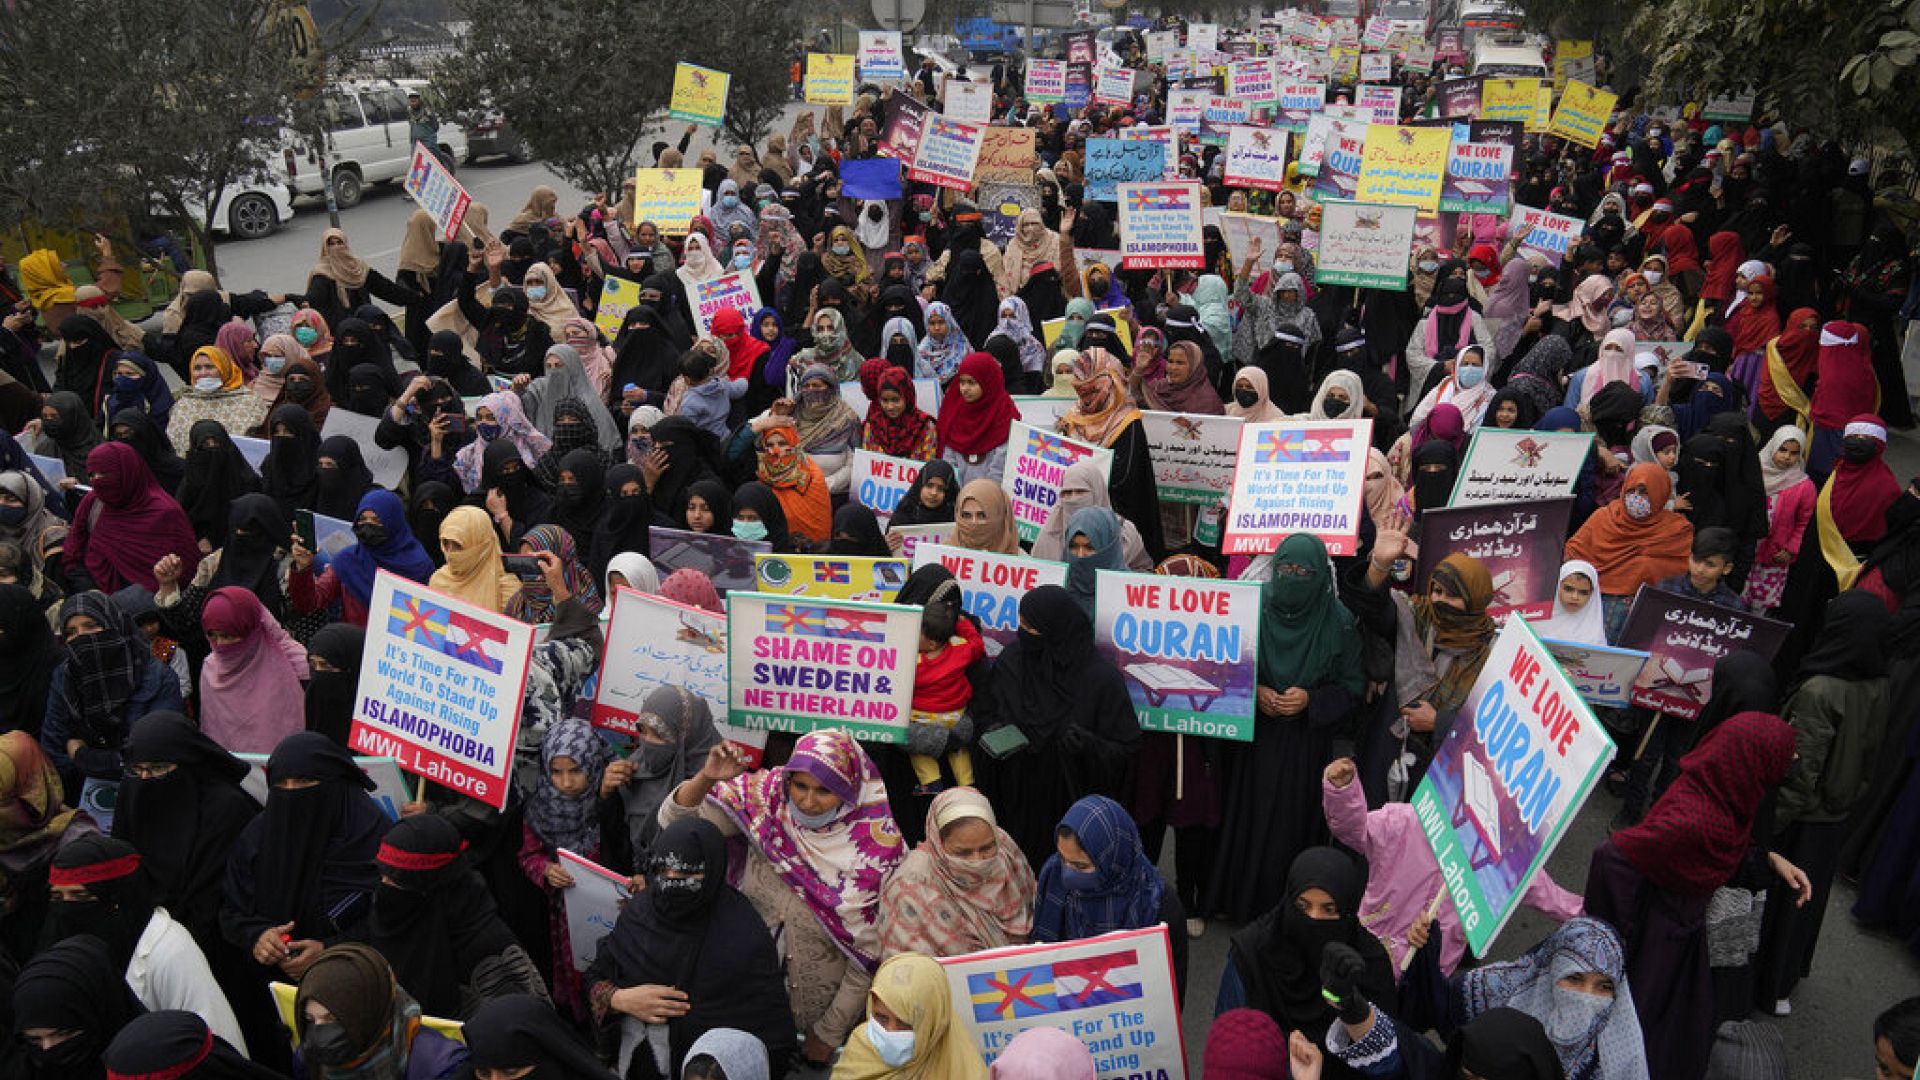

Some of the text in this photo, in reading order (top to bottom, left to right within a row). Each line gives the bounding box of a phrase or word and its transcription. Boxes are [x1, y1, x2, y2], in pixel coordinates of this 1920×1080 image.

[1330, 150, 1362, 175] QUR
[1457, 145, 1502, 159] WE LOVE
[1450, 158, 1504, 181] QURAN
[1524, 212, 1571, 232] WE LOVE
[1126, 242, 1198, 252] ISLAMOPHOBIA
[1524, 230, 1570, 254] URAN
[1128, 258, 1198, 268] MWL Lahore
[736, 291, 752, 307] ON
[870, 460, 918, 484] WE LO
[1016, 454, 1064, 488] SHAM
[1254, 468, 1345, 480] It's Time For The
[1014, 477, 1057, 508] SWED
[1248, 483, 1348, 496] World To Stand Up
[1254, 497, 1334, 512] Against Rising
[1236, 512, 1348, 528] ISLAMOPHOBIA
[1449, 512, 1538, 540] قرآن ہماری
[1233, 537, 1275, 553] MWL
[941, 554, 1039, 591] WE LOVE
[1125, 584, 1231, 615] WE LOVE
[1112, 612, 1240, 664] QURAN
[1664, 609, 1753, 640] قرآن ہماری
[753, 636, 897, 670] SHAME ON
[385, 644, 496, 697] It's Time For The
[754, 662, 871, 694] SWEDEN
[874, 676, 892, 695] &
[378, 659, 498, 720] World To Stand Up
[1508, 644, 1580, 758] WE LOVE
[386, 684, 480, 736] Against Rising
[744, 688, 898, 722] NETHERLAND
[362, 696, 495, 766] ISLAMOPHOBIA
[745, 714, 802, 733] MWL
[1163, 712, 1239, 736] Lahore
[358, 730, 488, 796] MWL Lahore
[1474, 680, 1561, 834] QURAN
[1418, 790, 1480, 932] MWL Lahore
[983, 1010, 1144, 1049] It's For The
[1083, 1030, 1156, 1054] and Up
[1094, 1053, 1140, 1074] ising
